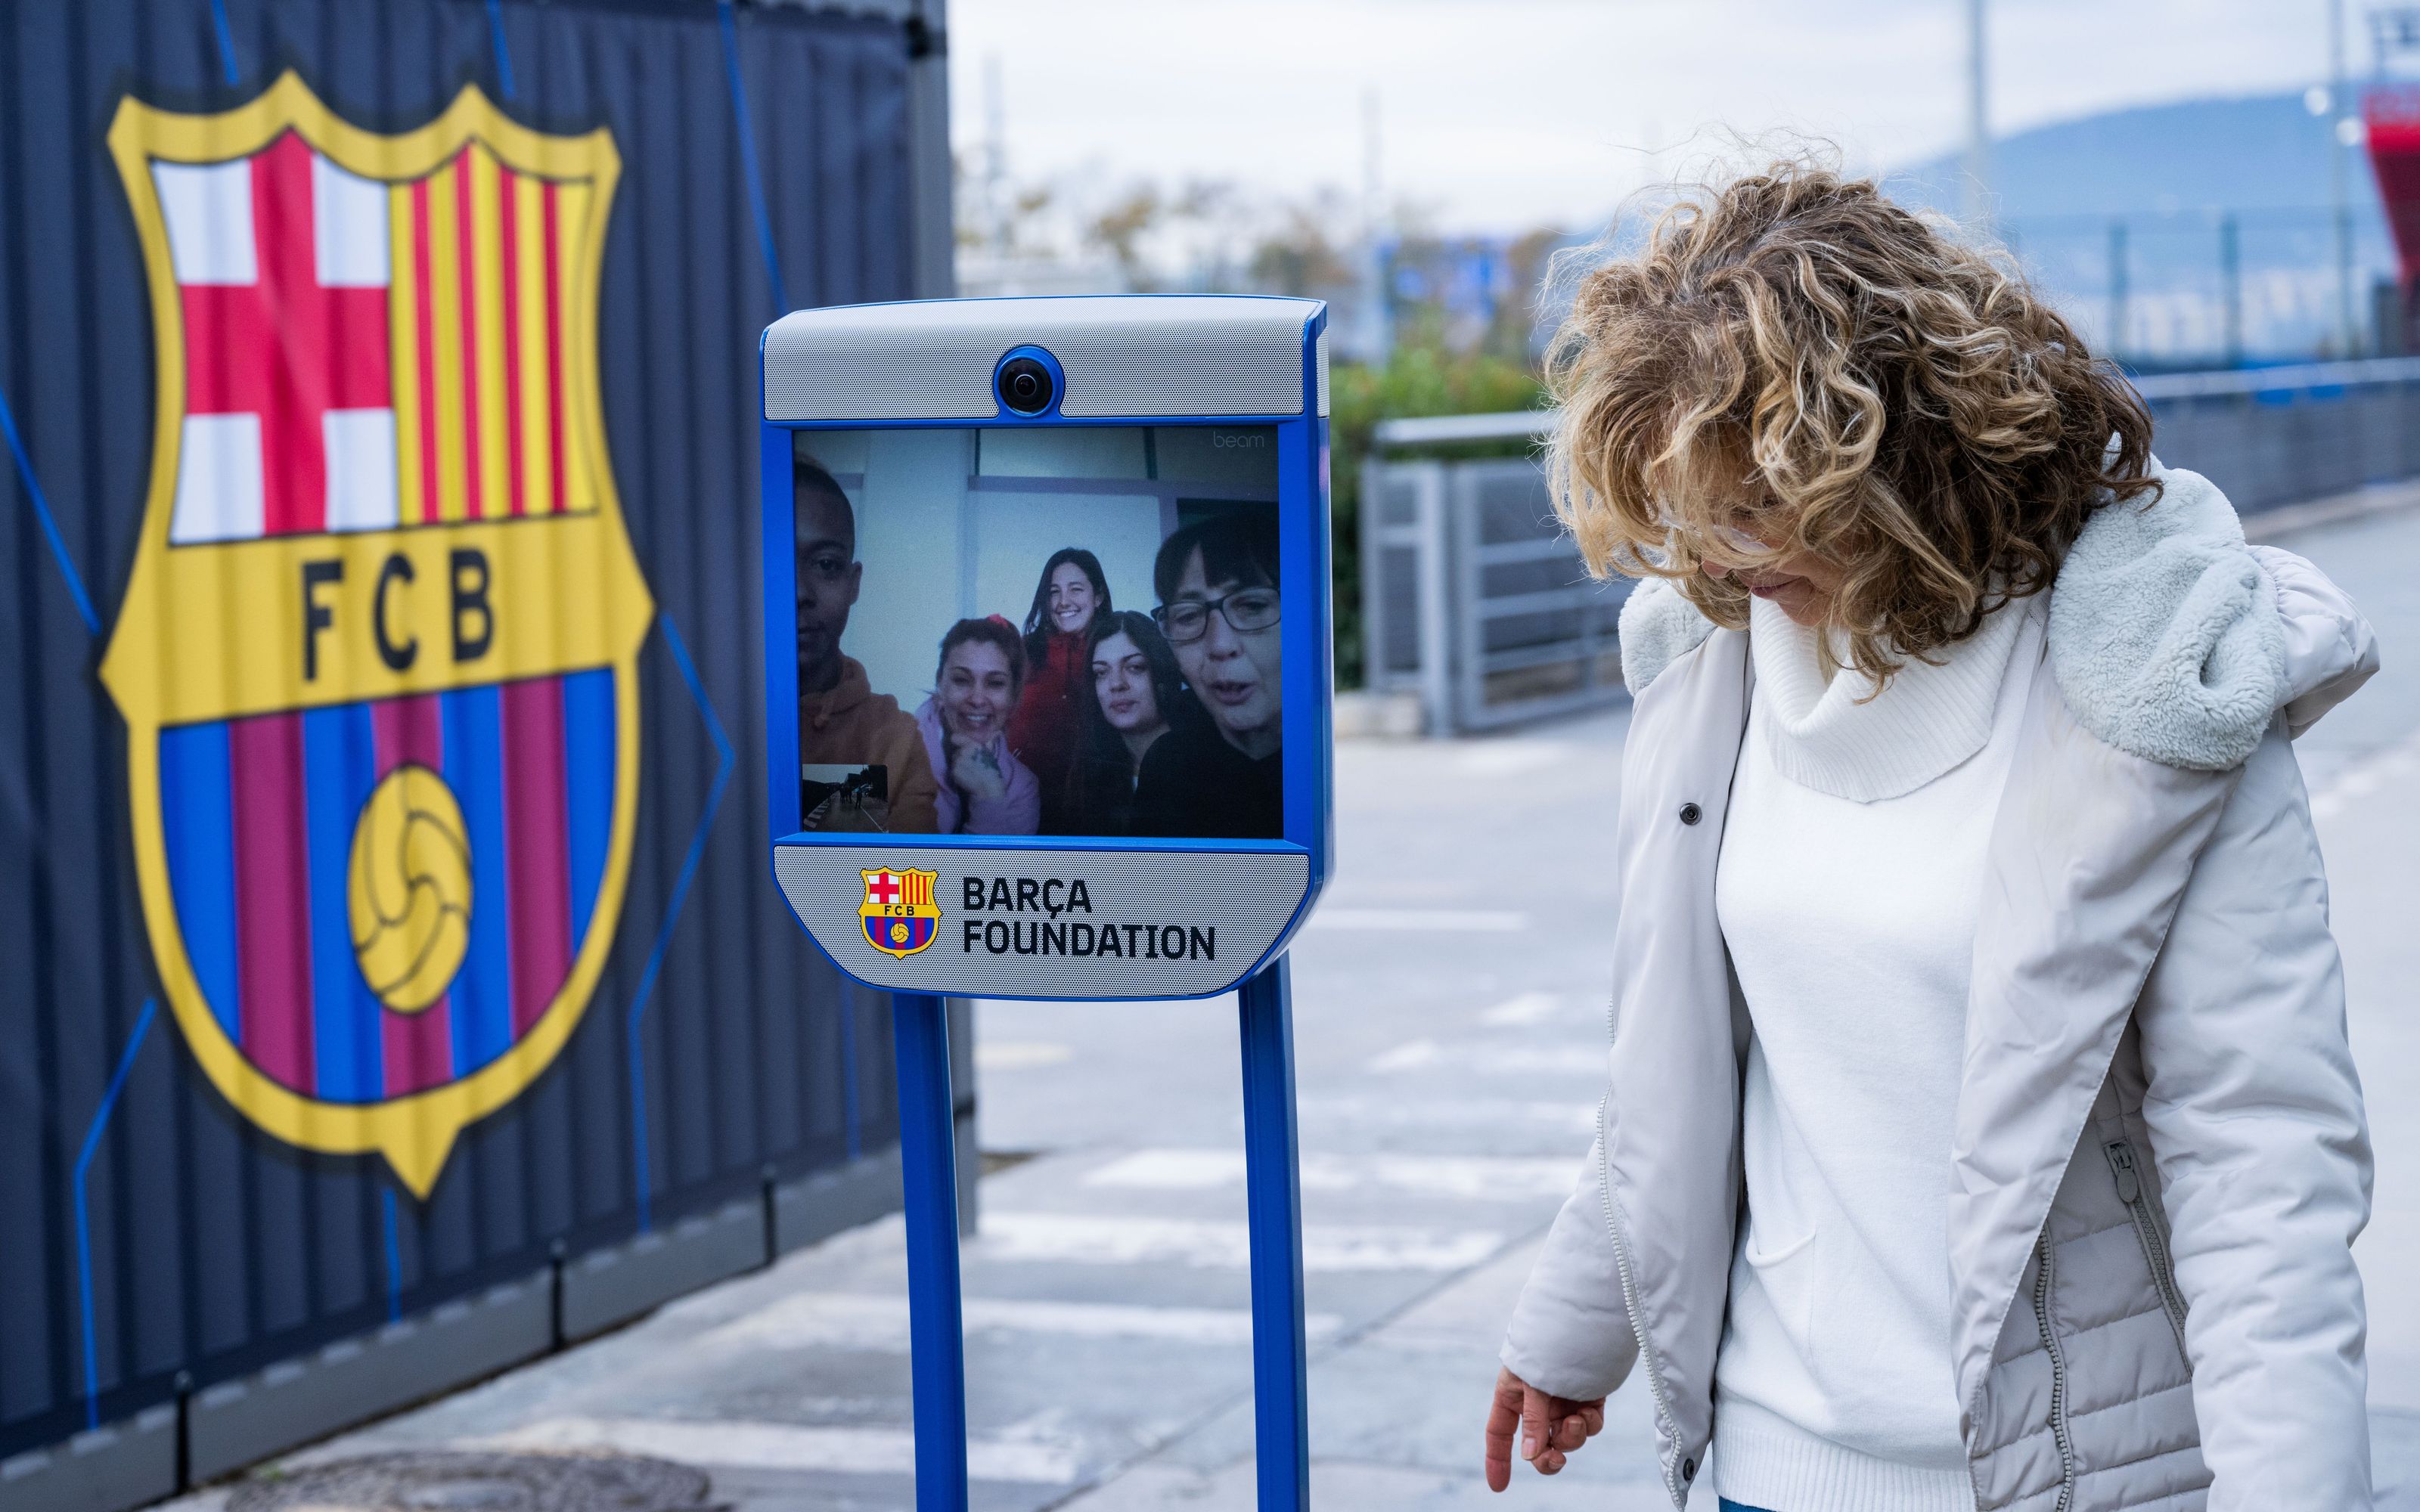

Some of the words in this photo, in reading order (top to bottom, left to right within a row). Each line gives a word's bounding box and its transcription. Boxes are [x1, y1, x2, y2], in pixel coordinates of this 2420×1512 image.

[1213, 430, 1264, 448] beam
[302, 547, 495, 682] FCB
[884, 905, 915, 916] FCB
[963, 876, 1093, 920] BARÇA
[963, 919, 1216, 961] FOUNDATION
